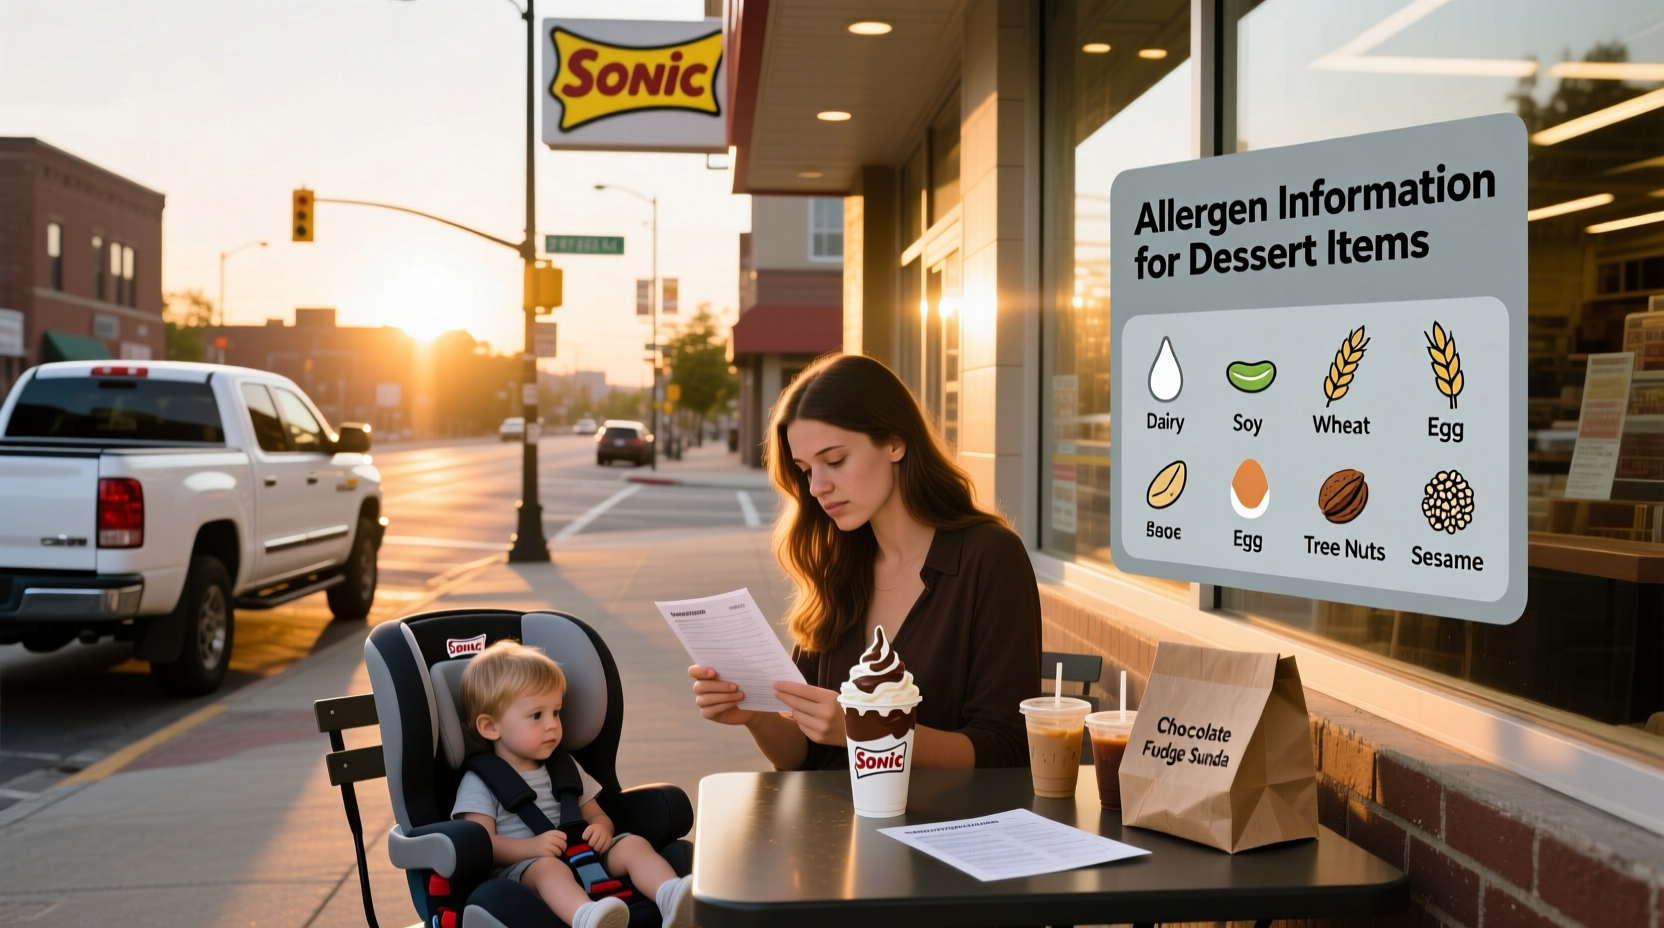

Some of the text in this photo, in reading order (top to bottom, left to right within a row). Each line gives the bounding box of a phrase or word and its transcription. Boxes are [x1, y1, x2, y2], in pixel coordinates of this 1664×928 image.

[1133, 163, 1496, 237] Allergen Information
[1134, 228, 1430, 281] for Dessert Items
[1146, 412, 1185, 435] Dairy
[1232, 413, 1263, 438] Soy
[1312, 414, 1371, 435] Wheat
[1428, 416, 1464, 443] Egg
[1233, 529, 1263, 553] Egg
[1303, 535, 1386, 562] Tree Nuts
[1411, 545, 1484, 572] Sesame
[1157, 716, 1232, 743] Chocolate
[1142, 740, 1230, 768] Fudge Sunda
